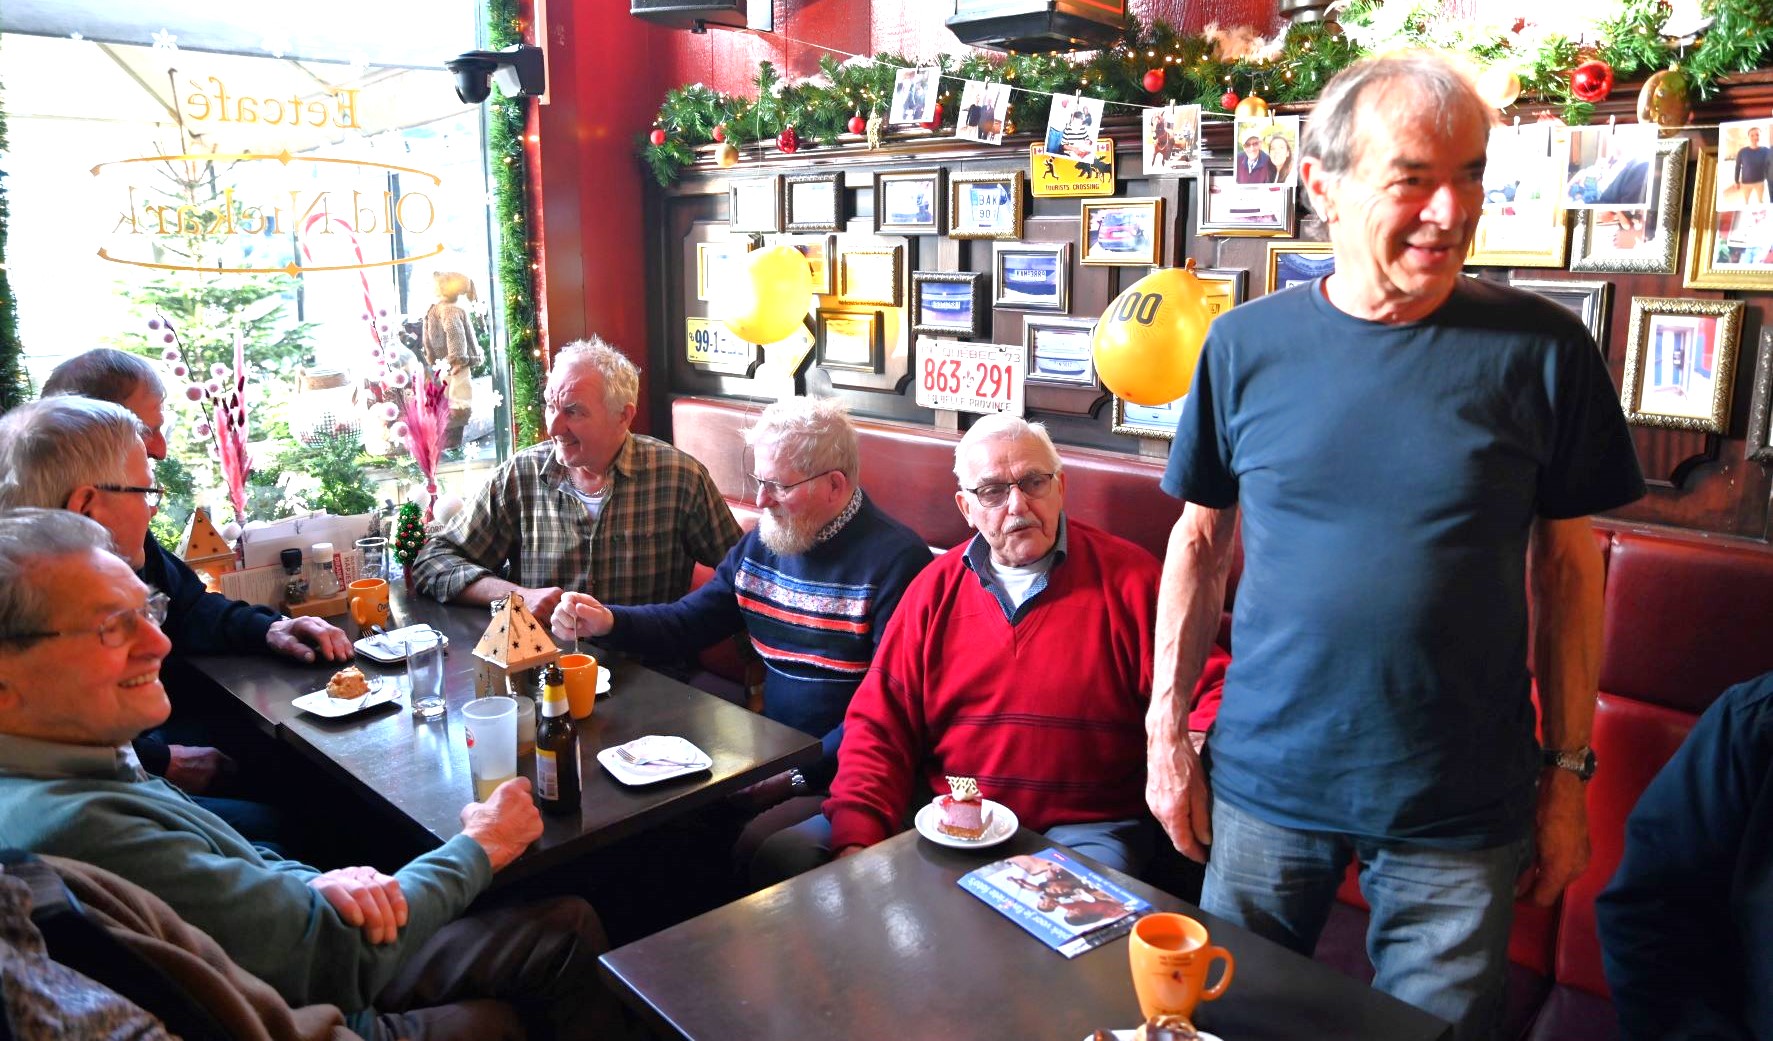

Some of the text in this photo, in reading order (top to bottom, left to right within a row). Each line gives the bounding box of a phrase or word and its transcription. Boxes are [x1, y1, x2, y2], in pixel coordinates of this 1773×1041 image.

[1072, 183, 1100, 191] CROSSING
[1108, 291, 1163, 326] 100
[923, 357, 1013, 401] 863 291
[969, 398, 1012, 412] PROVINCE
